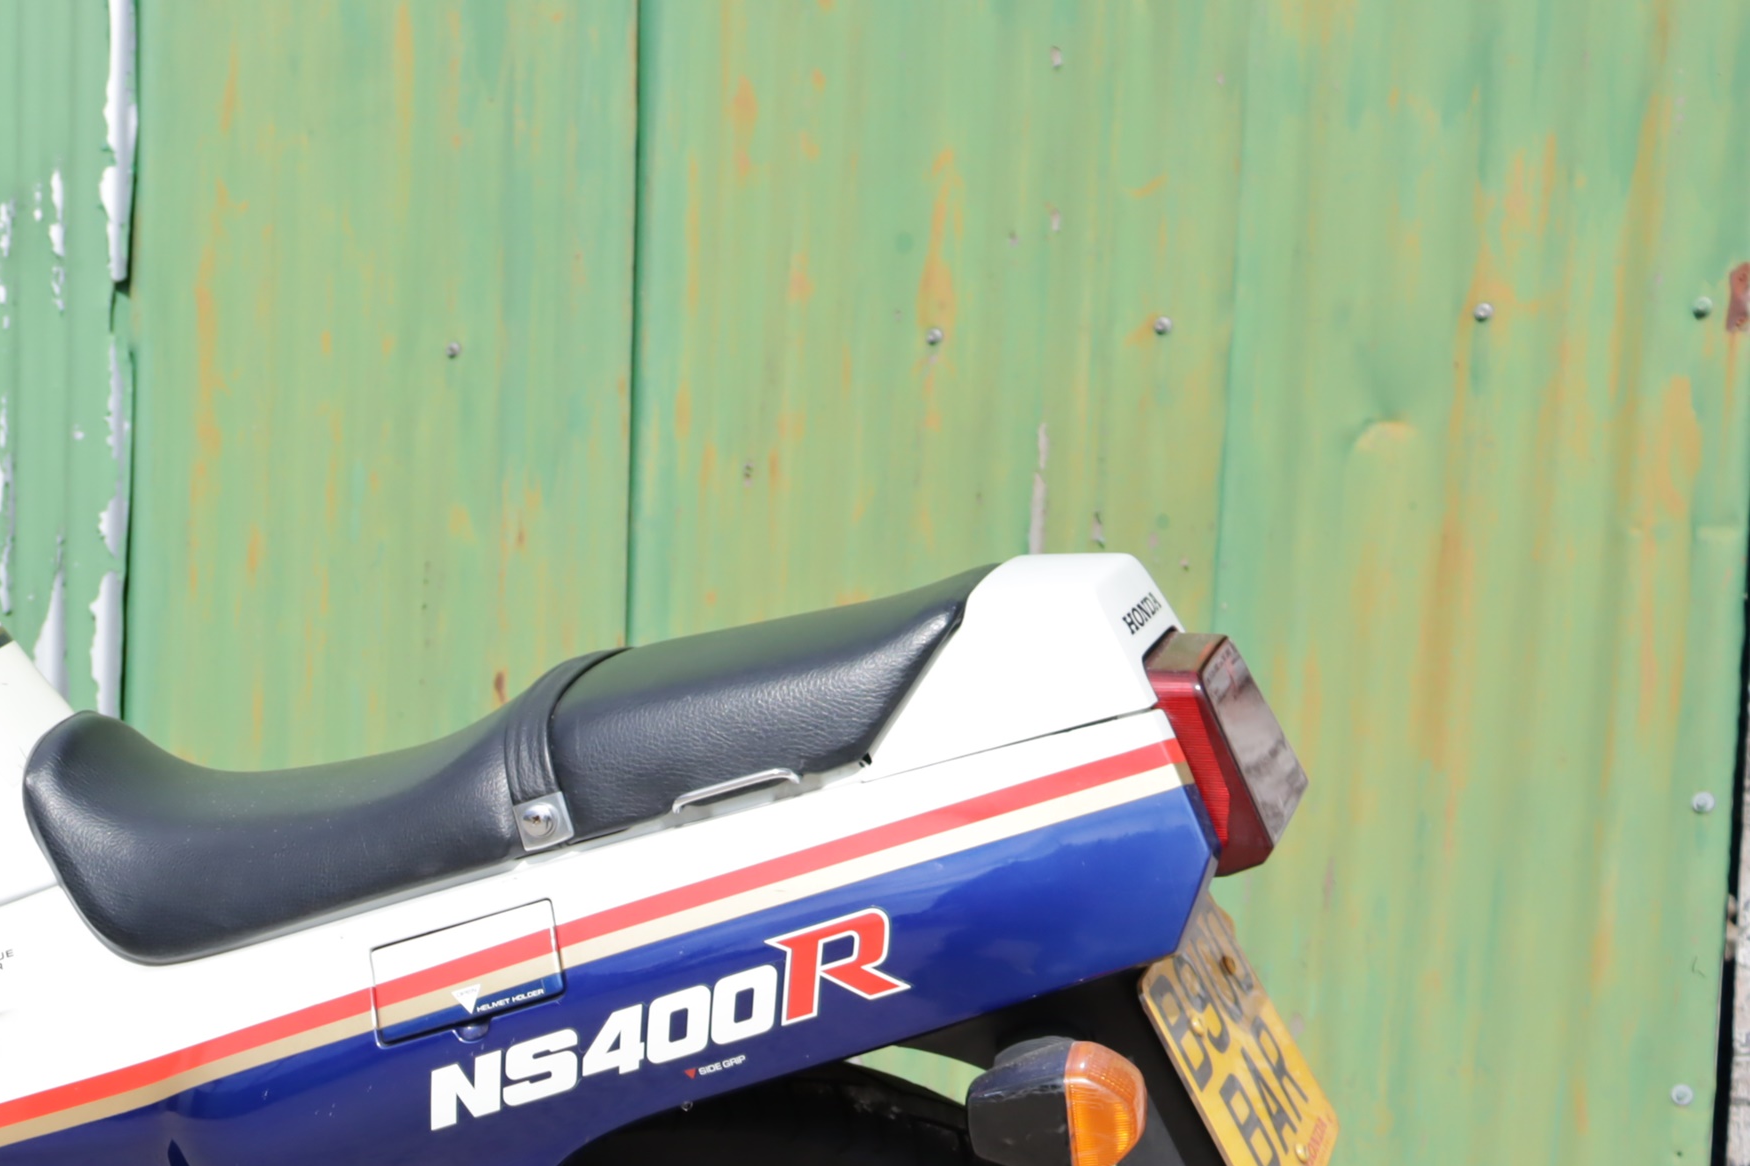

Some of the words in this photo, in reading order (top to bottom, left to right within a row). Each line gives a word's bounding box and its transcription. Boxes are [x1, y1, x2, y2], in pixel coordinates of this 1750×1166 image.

[1122, 591, 1163, 635] HONDA
[476, 997, 511, 1012] HELMET
[511, 987, 546, 1003] HOLDER
[429, 906, 912, 1132] NS400R
[698, 1061, 723, 1076] SIDE
[721, 1054, 747, 1069] GRIP
